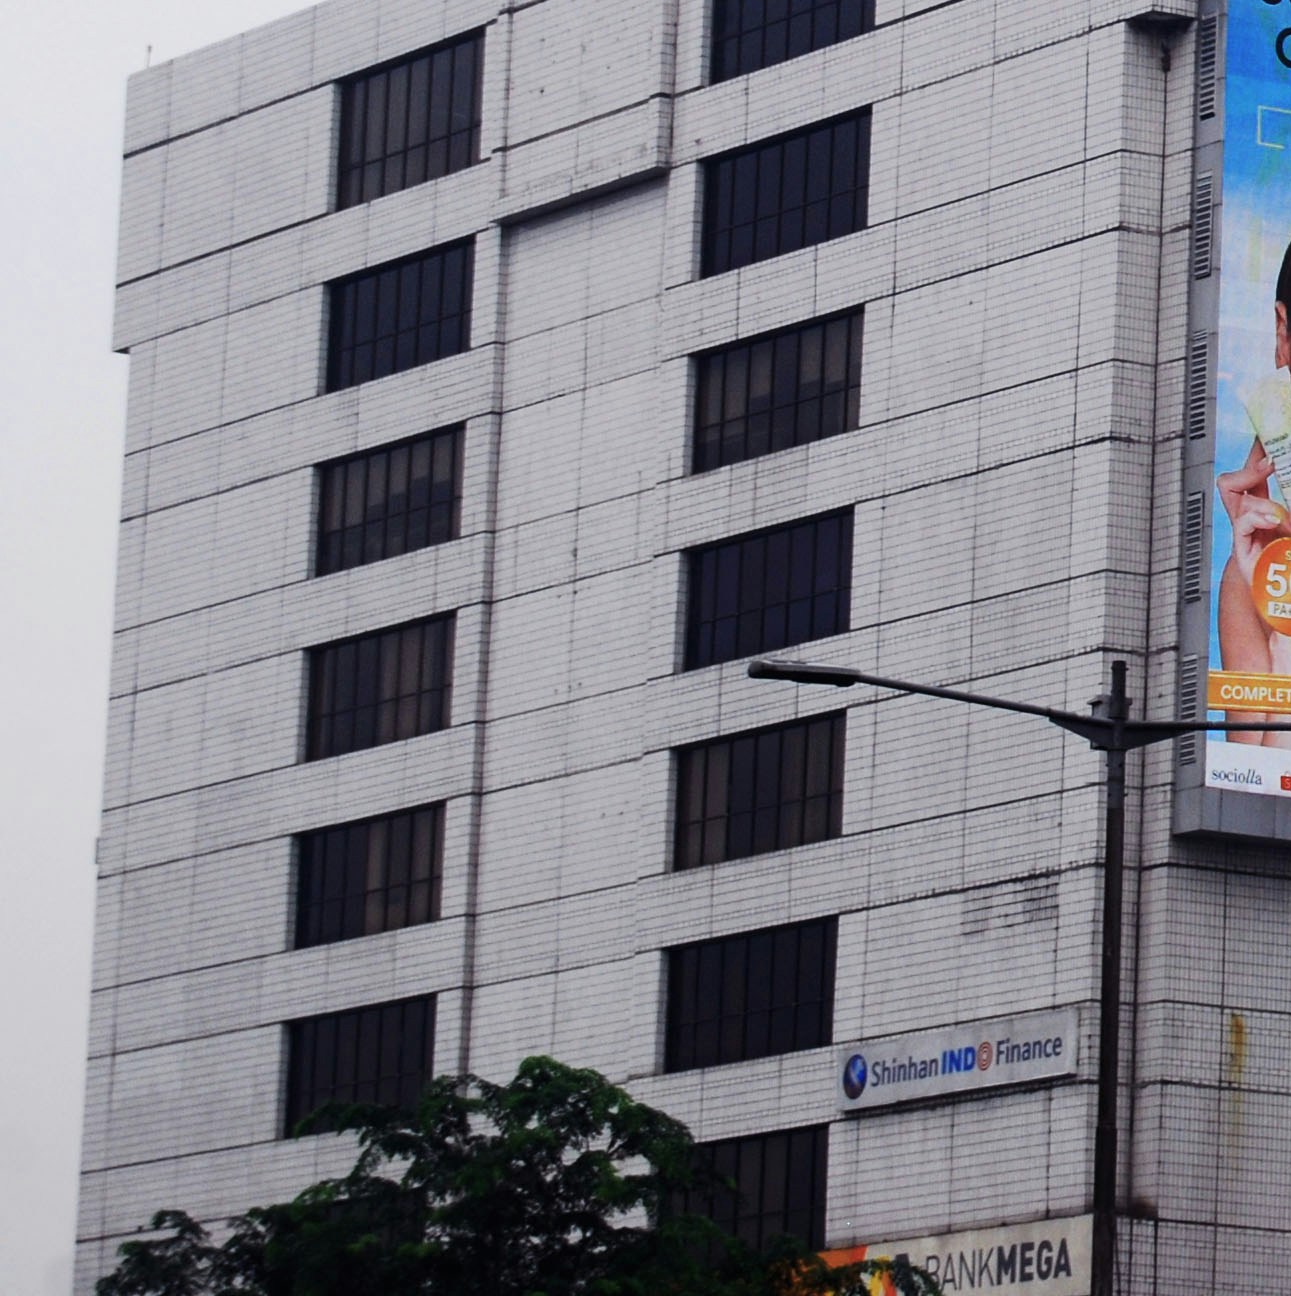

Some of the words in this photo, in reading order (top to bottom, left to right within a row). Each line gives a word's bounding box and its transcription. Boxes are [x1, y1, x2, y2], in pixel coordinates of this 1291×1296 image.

[1211, 768, 1262, 785] sociolla
[870, 1056, 938, 1087] Shinhan
[995, 1036, 1062, 1065] Finance
